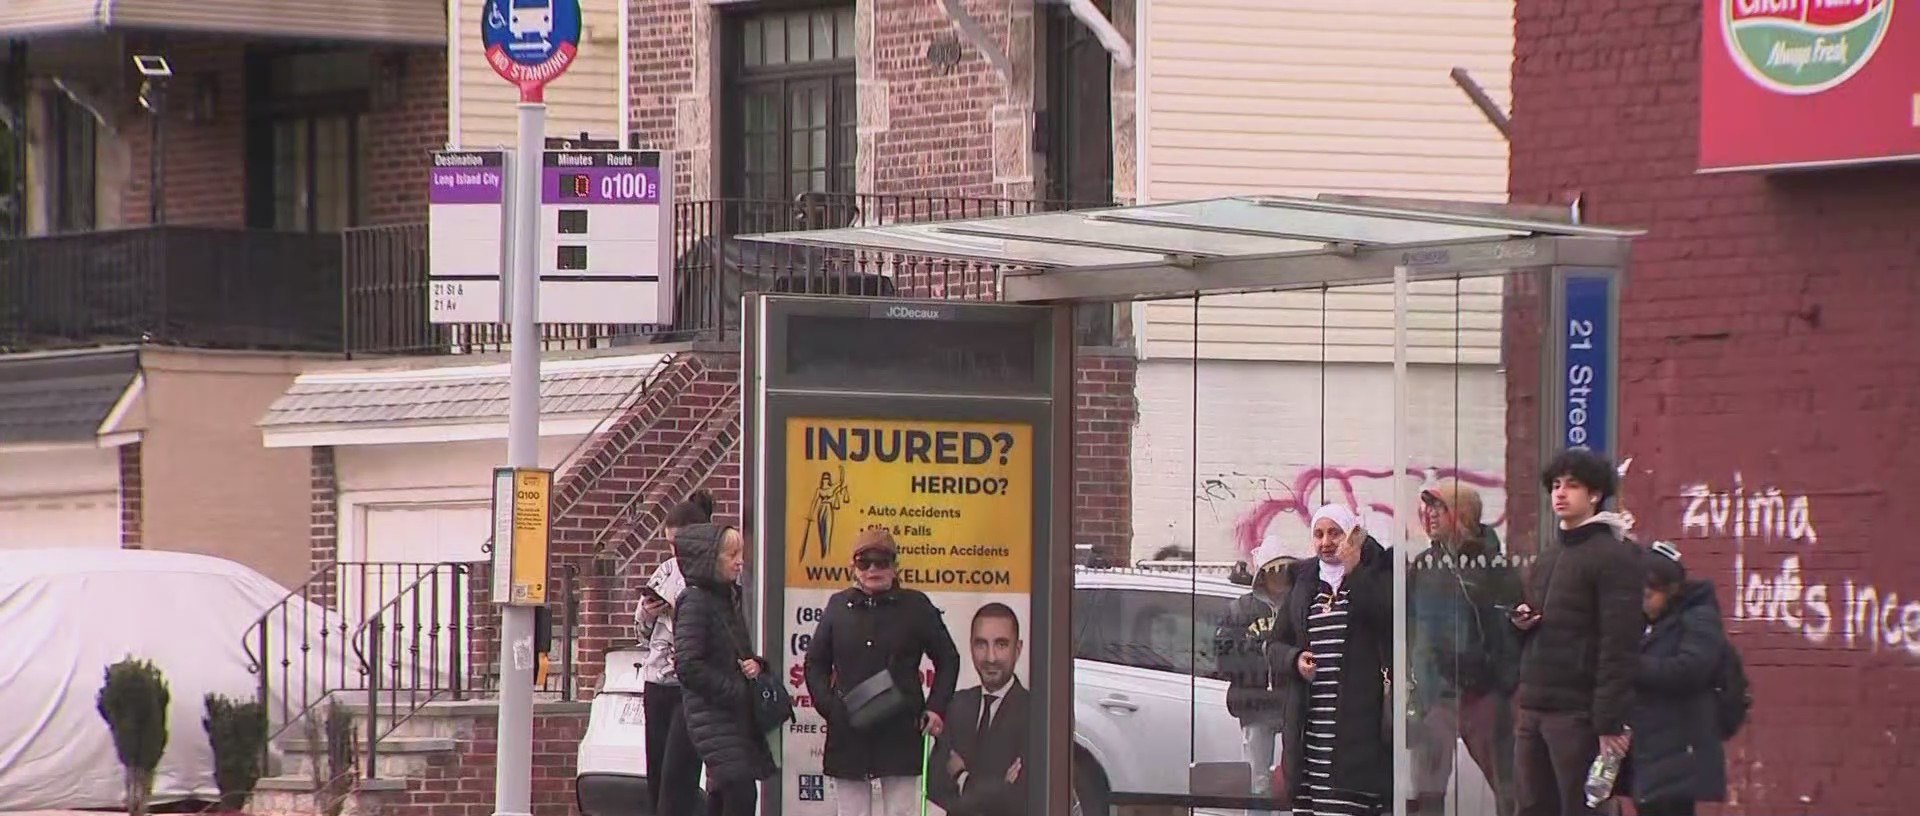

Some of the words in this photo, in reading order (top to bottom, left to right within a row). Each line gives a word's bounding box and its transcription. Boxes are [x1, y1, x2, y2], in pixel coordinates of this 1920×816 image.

[511, 49, 568, 80] STANDING
[435, 153, 484, 166] Destination
[558, 153, 593, 166] Minutes
[607, 153, 633, 166] Route
[434, 172, 455, 187] Long
[456, 172, 482, 185] Island
[483, 172, 499, 188] City
[575, 175, 590, 197] 0
[601, 173, 647, 199] Q100
[435, 284, 444, 295] 21
[435, 300, 444, 310] 21
[887, 306, 939, 318] JCDecaux
[1569, 320, 1593, 350] 21
[805, 426, 1014, 465] INJURED?
[911, 475, 1009, 496] HERIDO?
[518, 490, 540, 500] Q100
[867, 505, 897, 517] Auto
[899, 506, 961, 518] Accidents
[893, 525, 901, 536] &
[904, 525, 932, 536] Falls
[896, 543, 946, 555] truction
[950, 544, 1009, 557] Accidents
[790, 724, 817, 734] FREE
